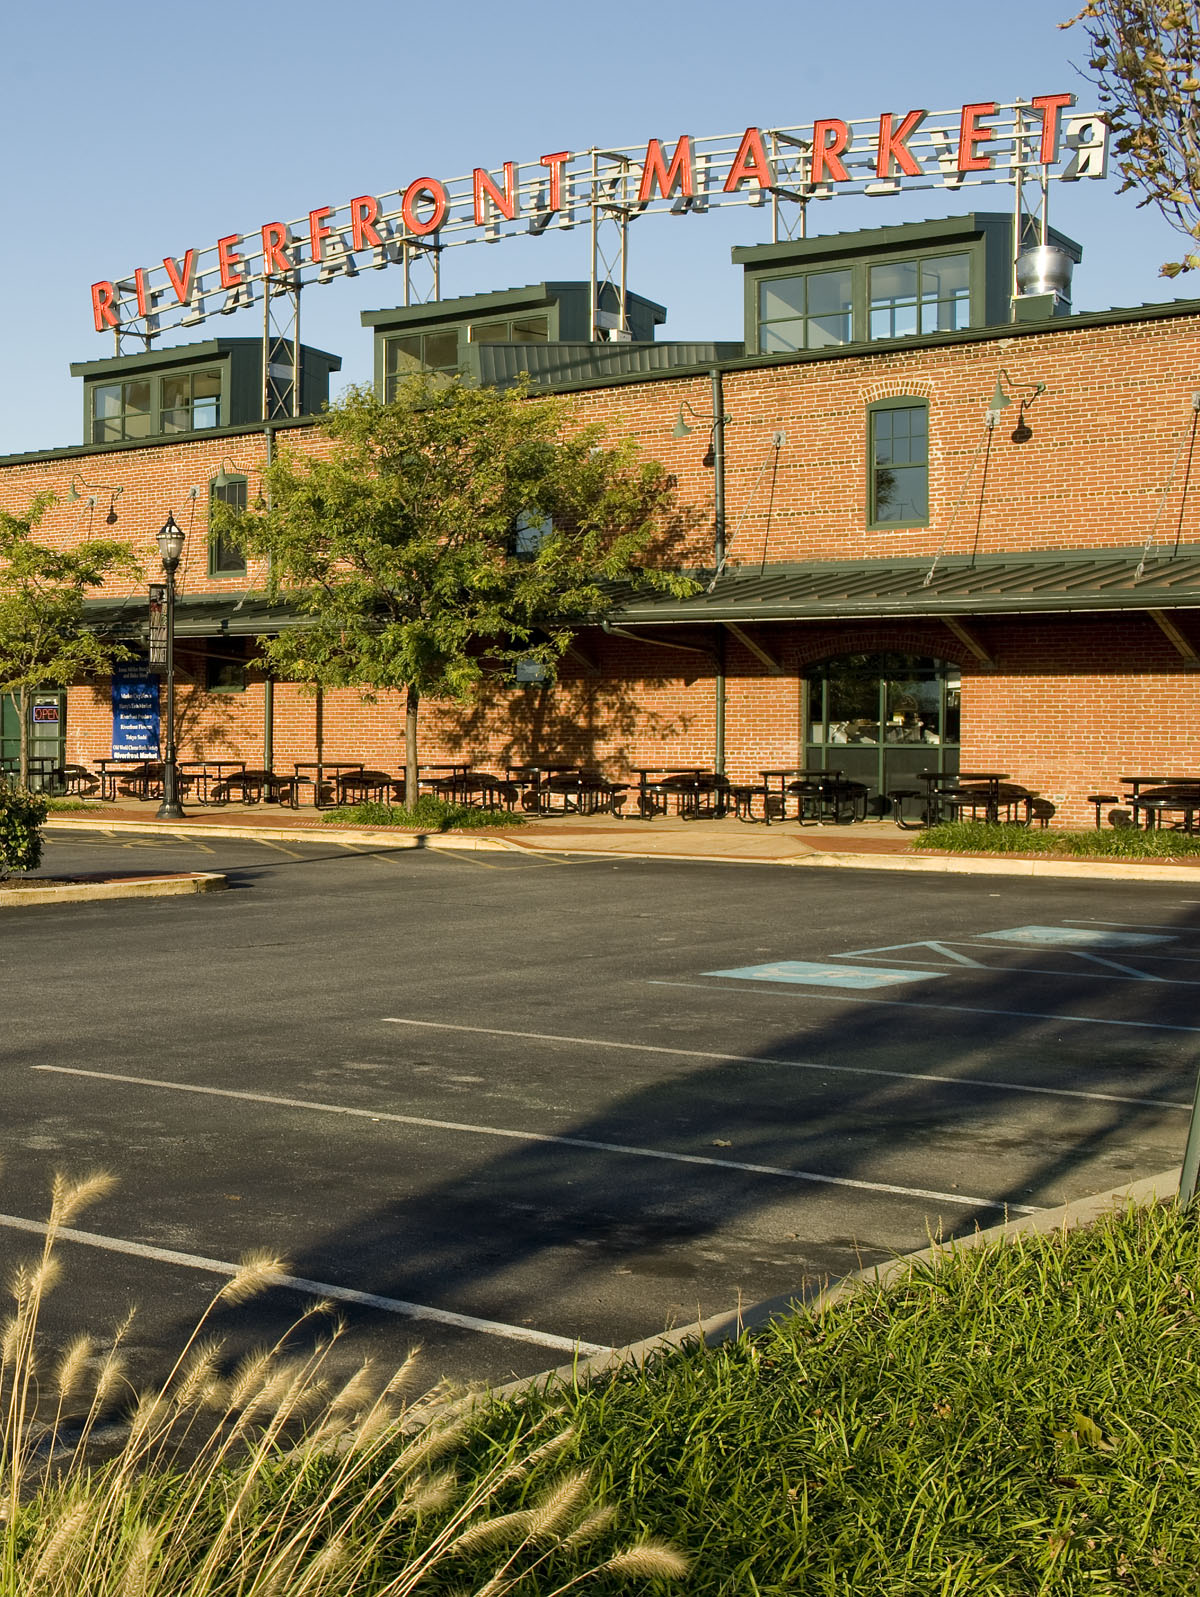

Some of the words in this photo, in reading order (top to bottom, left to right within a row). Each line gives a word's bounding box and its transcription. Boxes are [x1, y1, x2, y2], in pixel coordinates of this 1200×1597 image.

[91, 151, 574, 332] RIVERFRONT
[638, 93, 1077, 201] MARKET
[35, 709, 59, 720] OPEN
